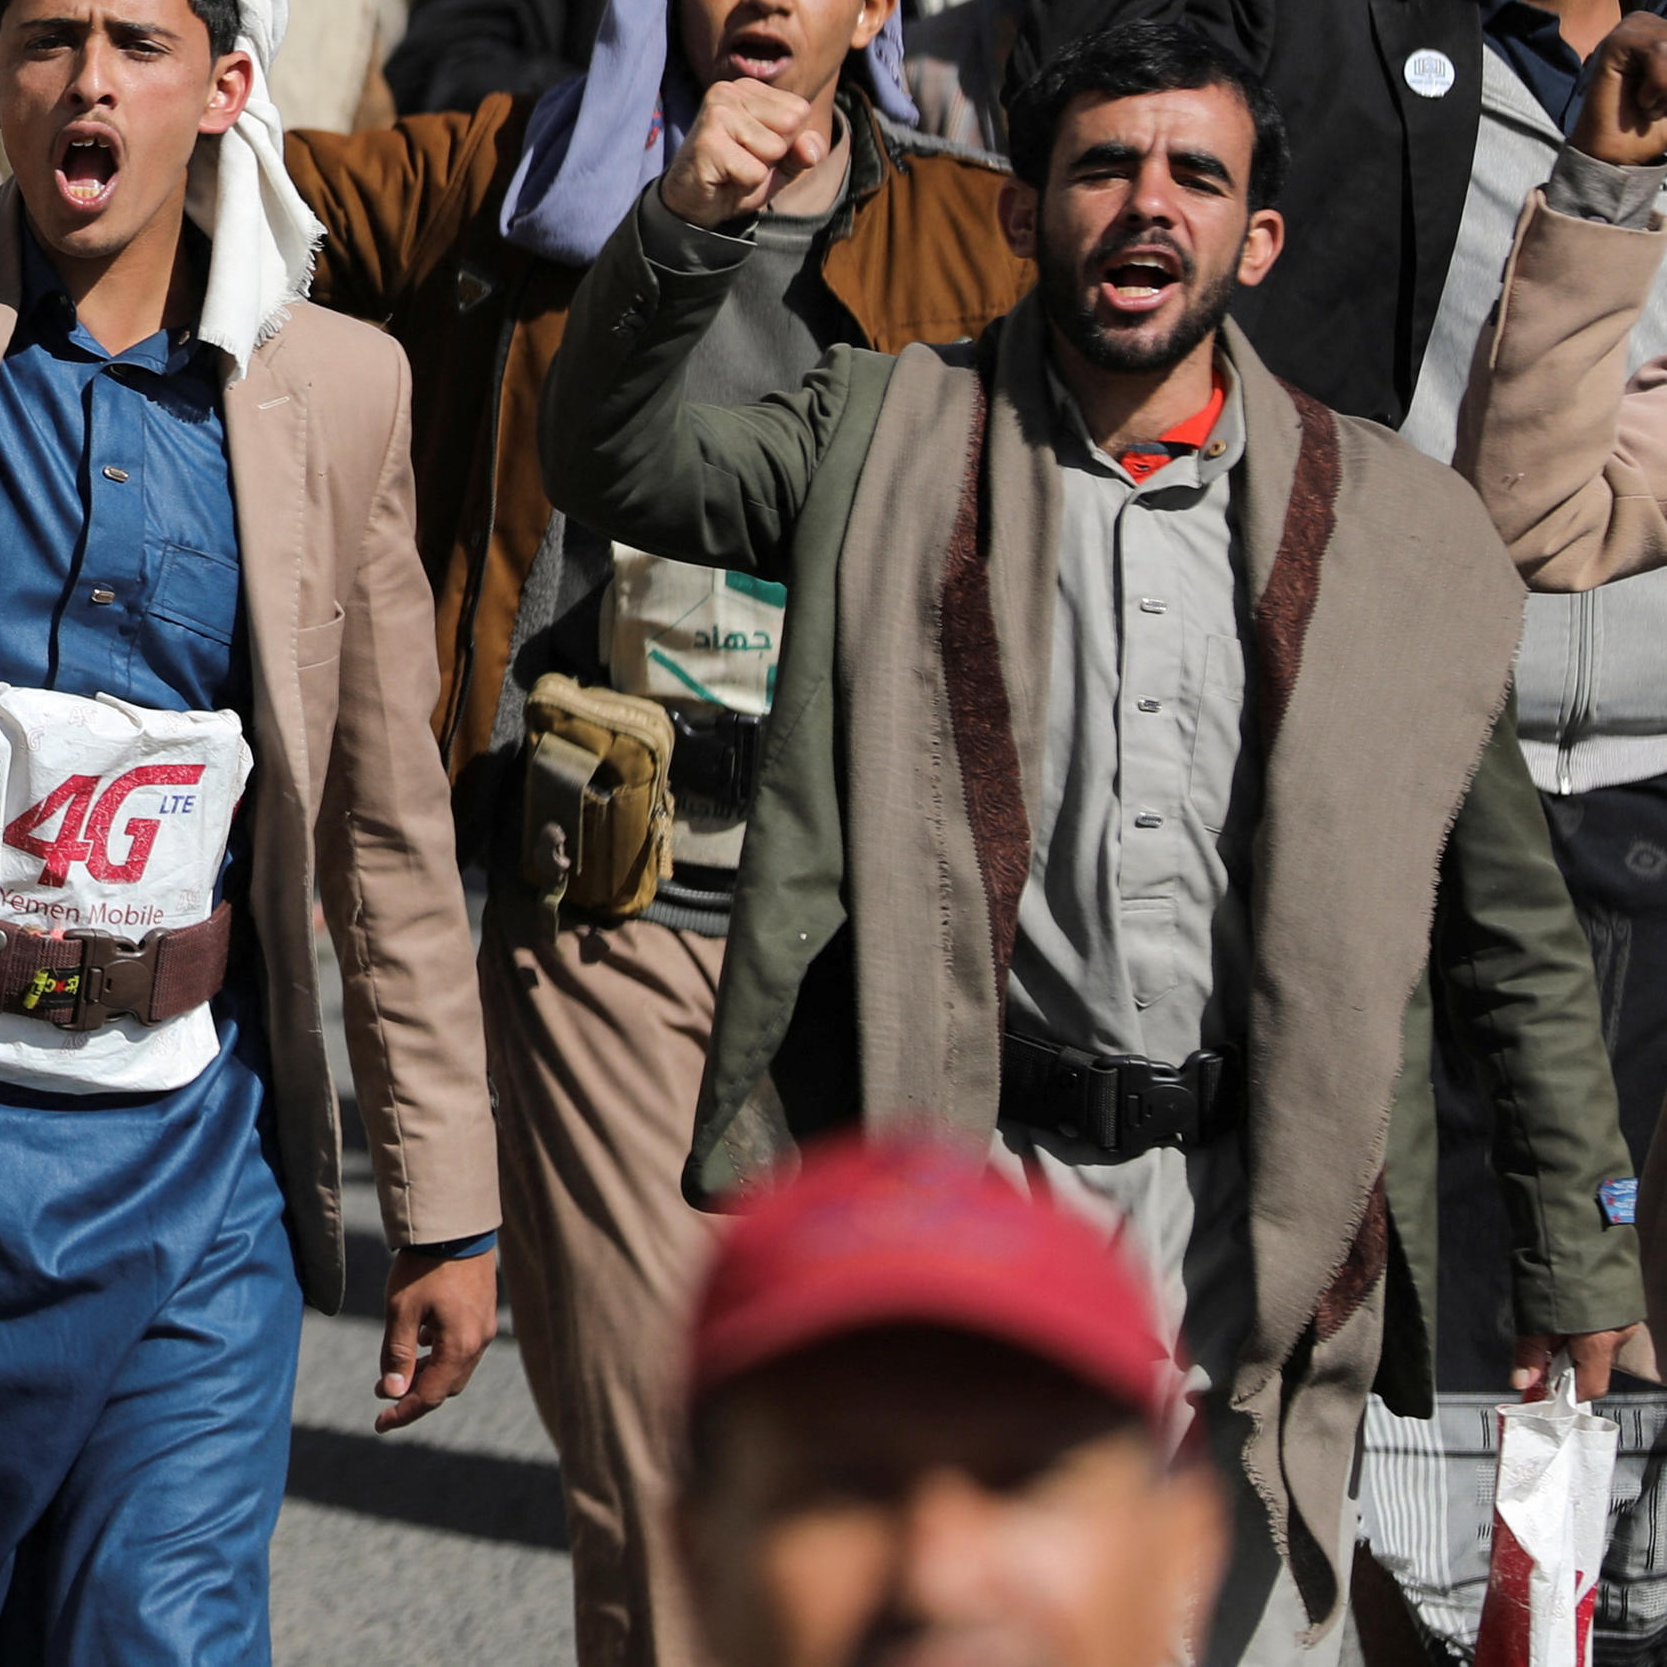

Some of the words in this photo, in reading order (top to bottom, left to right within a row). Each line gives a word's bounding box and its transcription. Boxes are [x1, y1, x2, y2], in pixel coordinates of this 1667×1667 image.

[694, 624, 772, 659] جهاد
[159, 795, 197, 814] LTE
[3, 764, 206, 888] 4G
[0, 886, 81, 922] Yemen
[87, 903, 165, 926] Mobile
